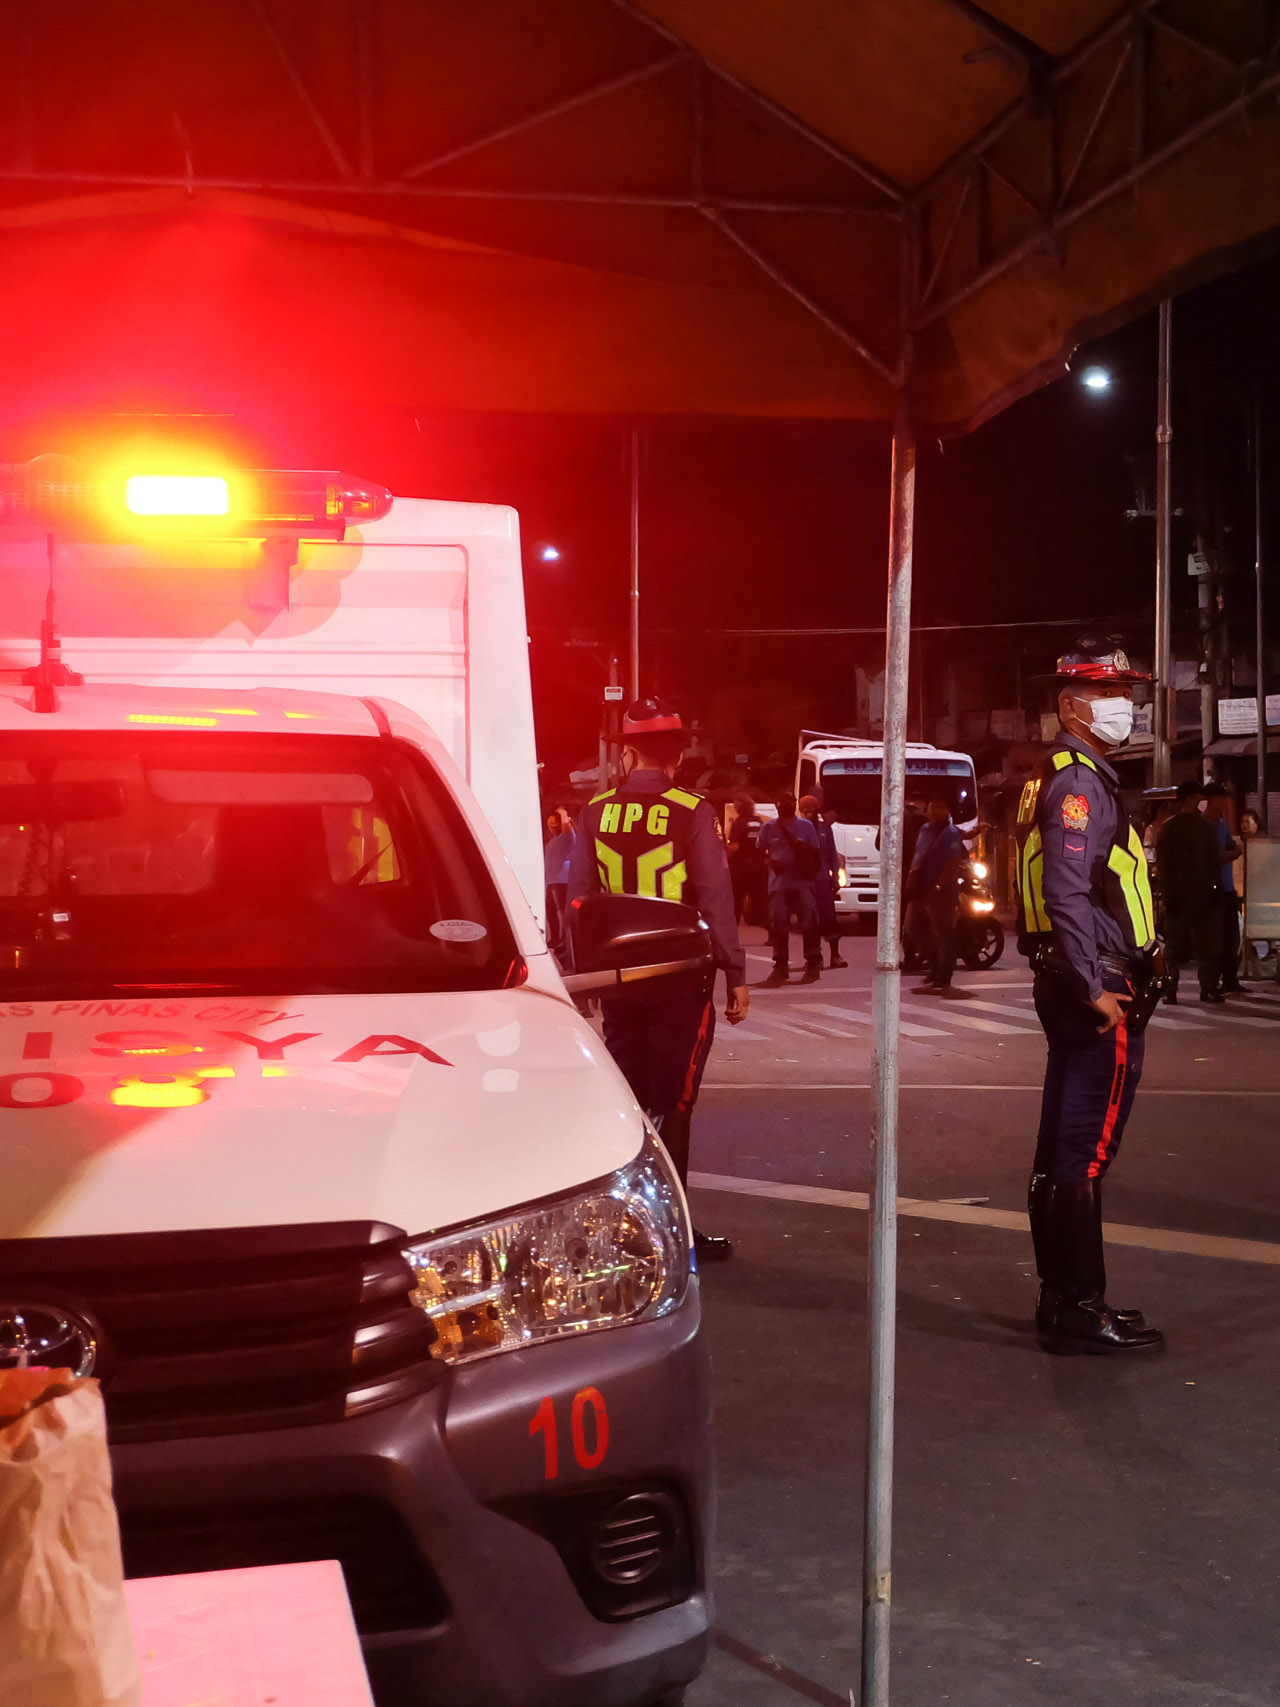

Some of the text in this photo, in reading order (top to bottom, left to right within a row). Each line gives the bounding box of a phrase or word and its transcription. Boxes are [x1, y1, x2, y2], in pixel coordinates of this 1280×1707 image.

[599, 802, 670, 836] HPG
[51, 1002, 188, 1018] PINAS
[194, 1006, 304, 1026] CITY
[528, 1386, 610, 1480] 10
